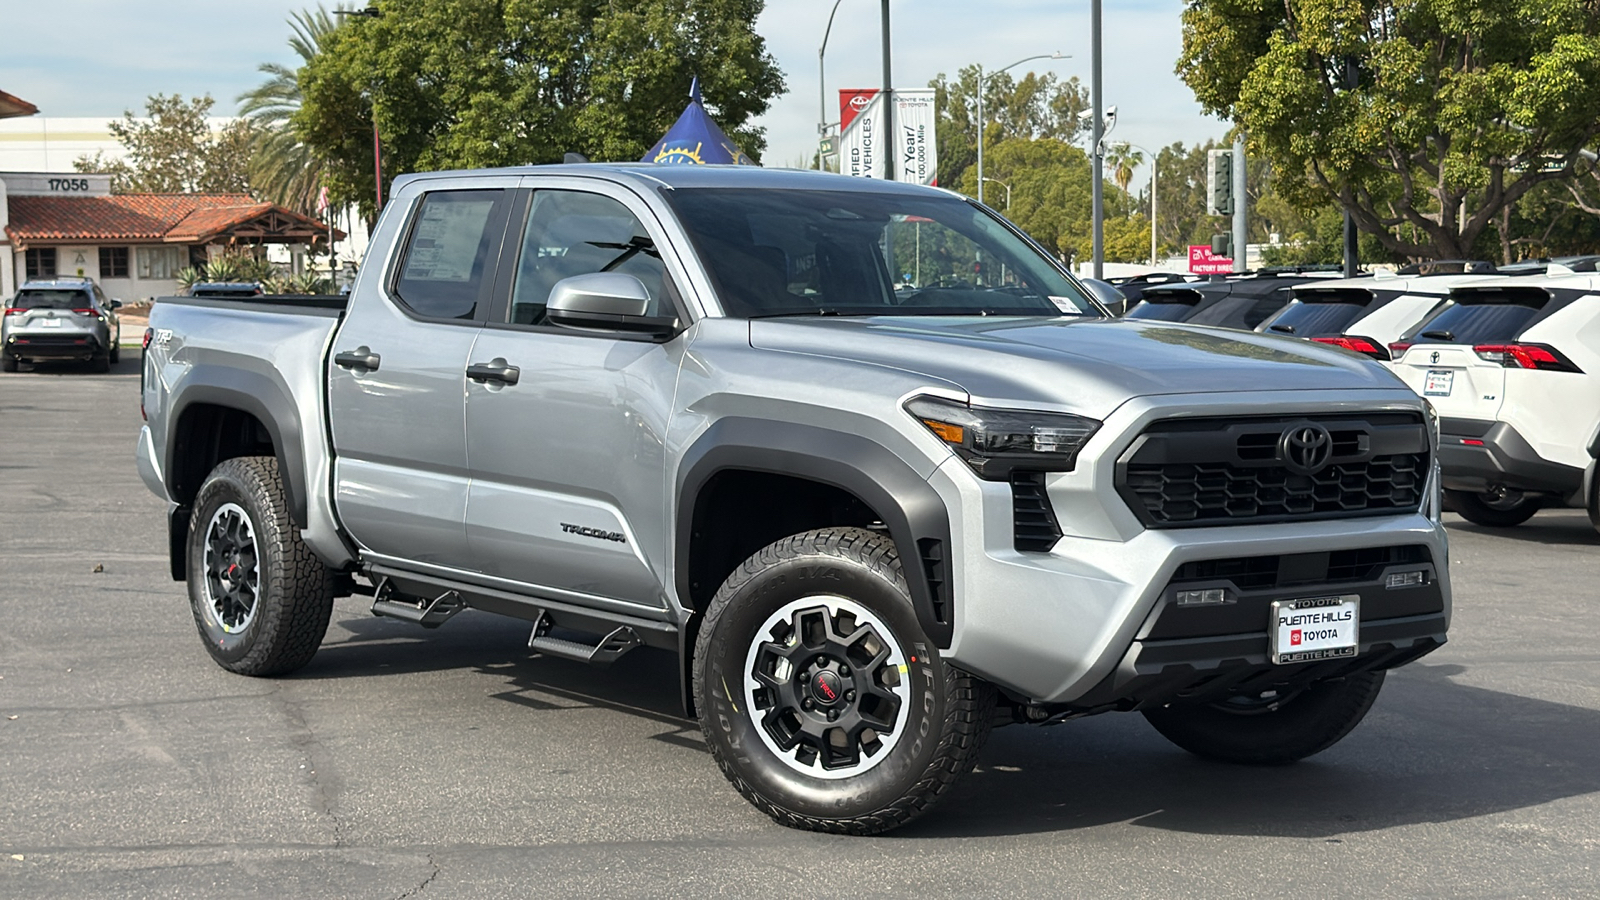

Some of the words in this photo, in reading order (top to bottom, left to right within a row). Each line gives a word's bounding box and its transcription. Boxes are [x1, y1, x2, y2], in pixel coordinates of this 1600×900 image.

[917, 124, 925, 144] Mile
[863, 118, 872, 172] VEHICLES
[904, 125, 916, 163] Year/
[918, 145, 927, 179] 100,000
[905, 167, 916, 175] 7
[48, 178, 89, 192] 17056
[1192, 264, 1216, 272] FACTORY
[560, 522, 626, 543] TACOMA
[1297, 598, 1339, 608] TOYOTA
[1279, 613, 1320, 627] PUENTE
[1321, 611, 1352, 623] HILLS
[1303, 629, 1338, 641] TOYOTA
[1280, 652, 1322, 663] PUENTE
[1323, 648, 1354, 657] HILLS
[818, 676, 836, 700] TRD
